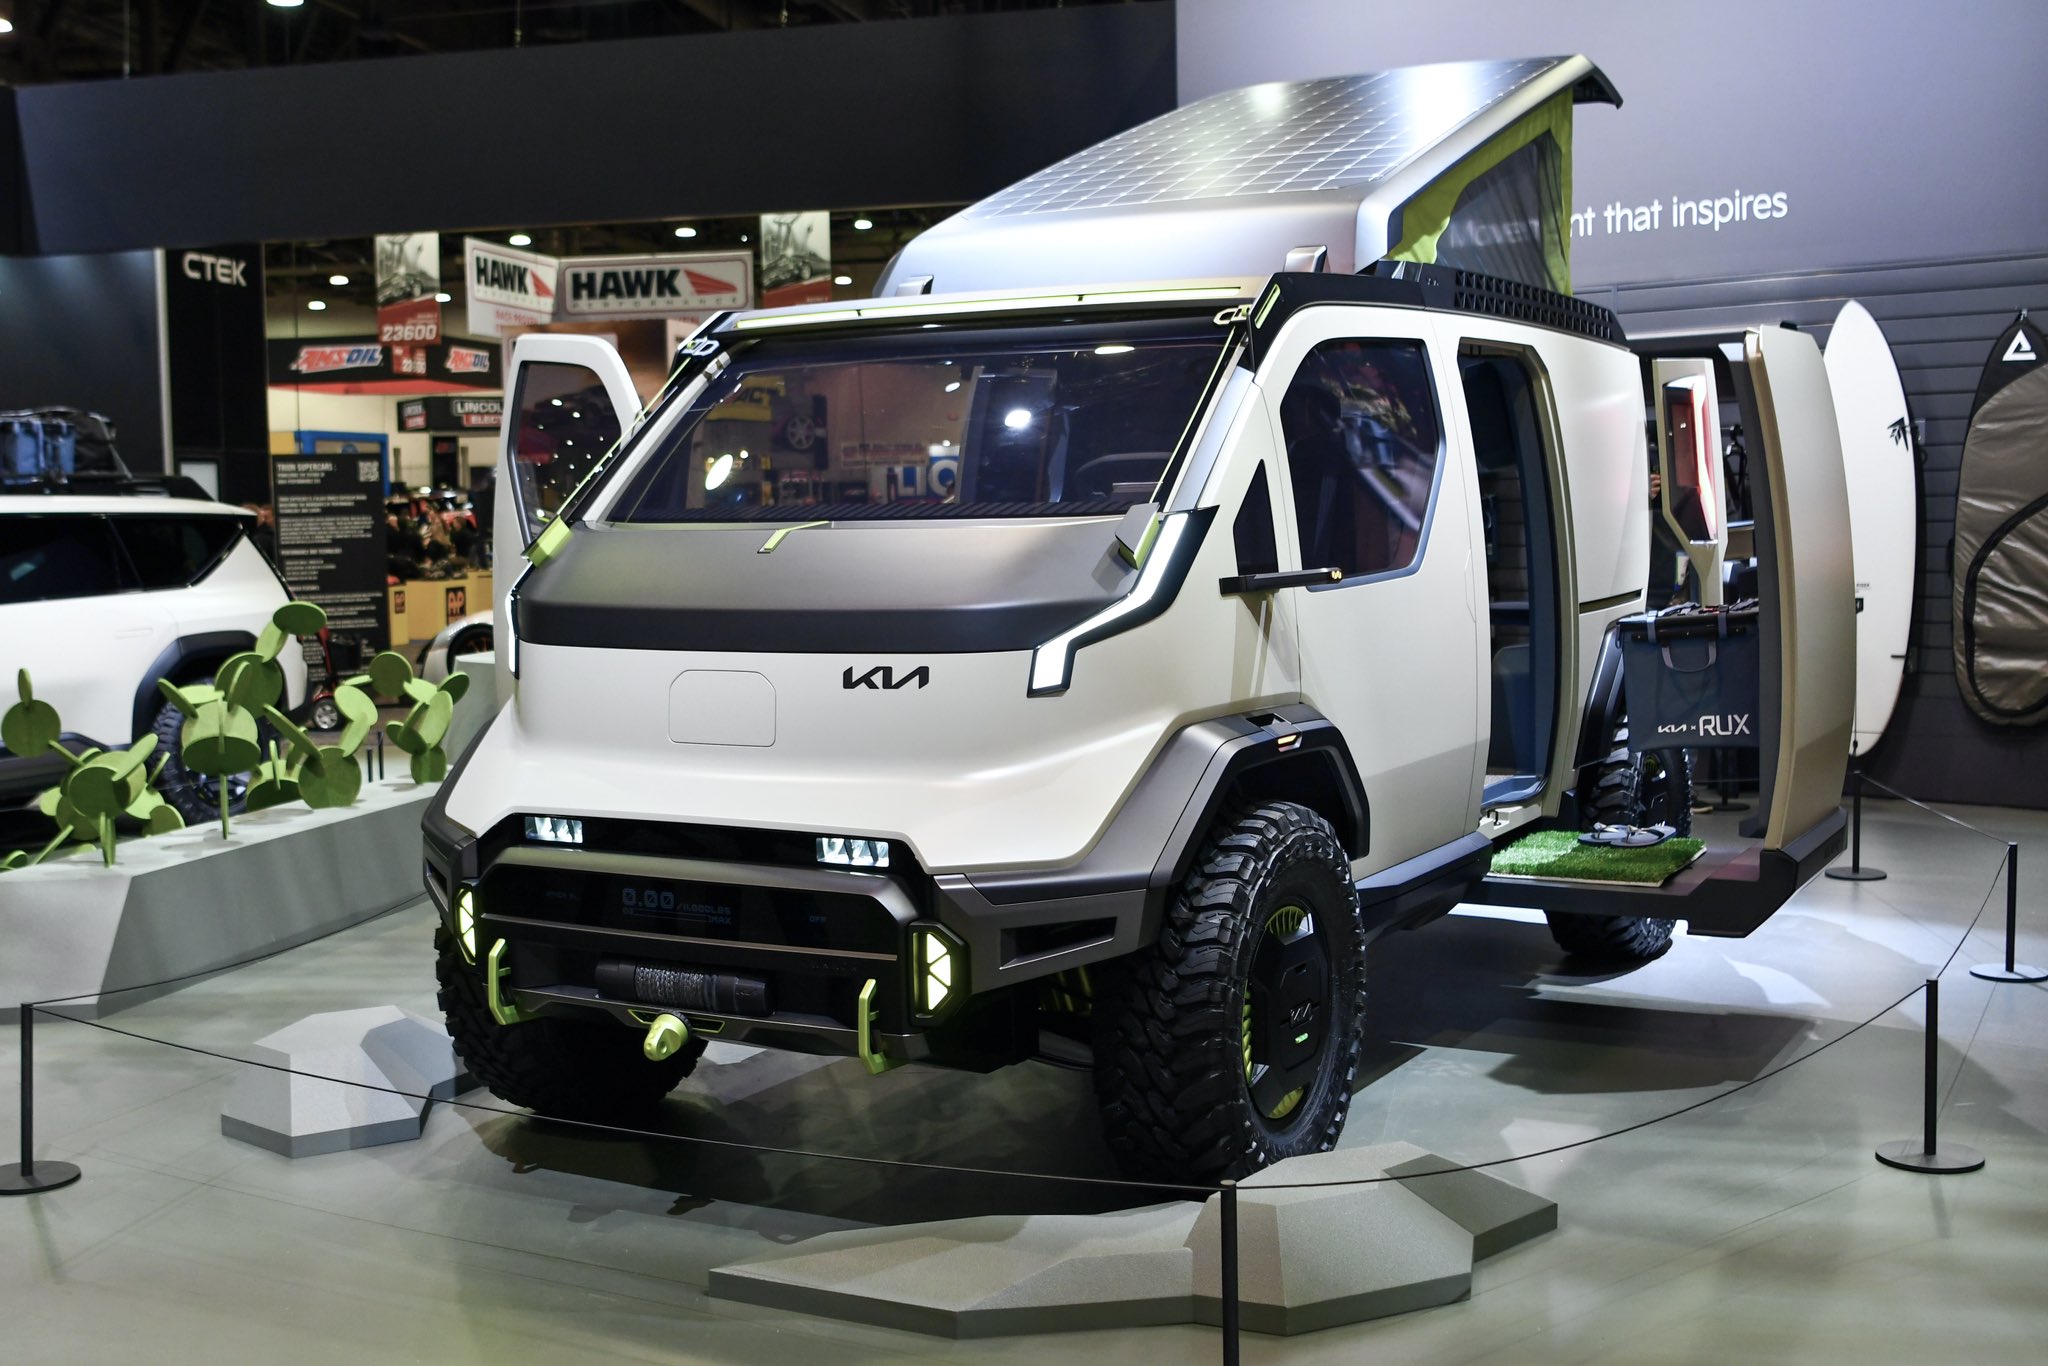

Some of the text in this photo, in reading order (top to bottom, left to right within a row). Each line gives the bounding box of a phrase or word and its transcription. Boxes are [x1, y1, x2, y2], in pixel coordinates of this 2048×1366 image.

[1604, 199, 1663, 234] that
[1673, 189, 1788, 231] inspires
[182, 251, 247, 287] CTEK
[475, 256, 529, 296] HAWK
[572, 269, 681, 301] HAWK
[381, 324, 438, 342] 23600
[292, 345, 383, 373] AMSOIL
[447, 348, 490, 372] AMSOIL
[842, 665, 931, 690] KIA
[1657, 724, 1688, 734] KIA
[1698, 713, 1751, 737] RUX
[622, 887, 676, 910] 0.00
